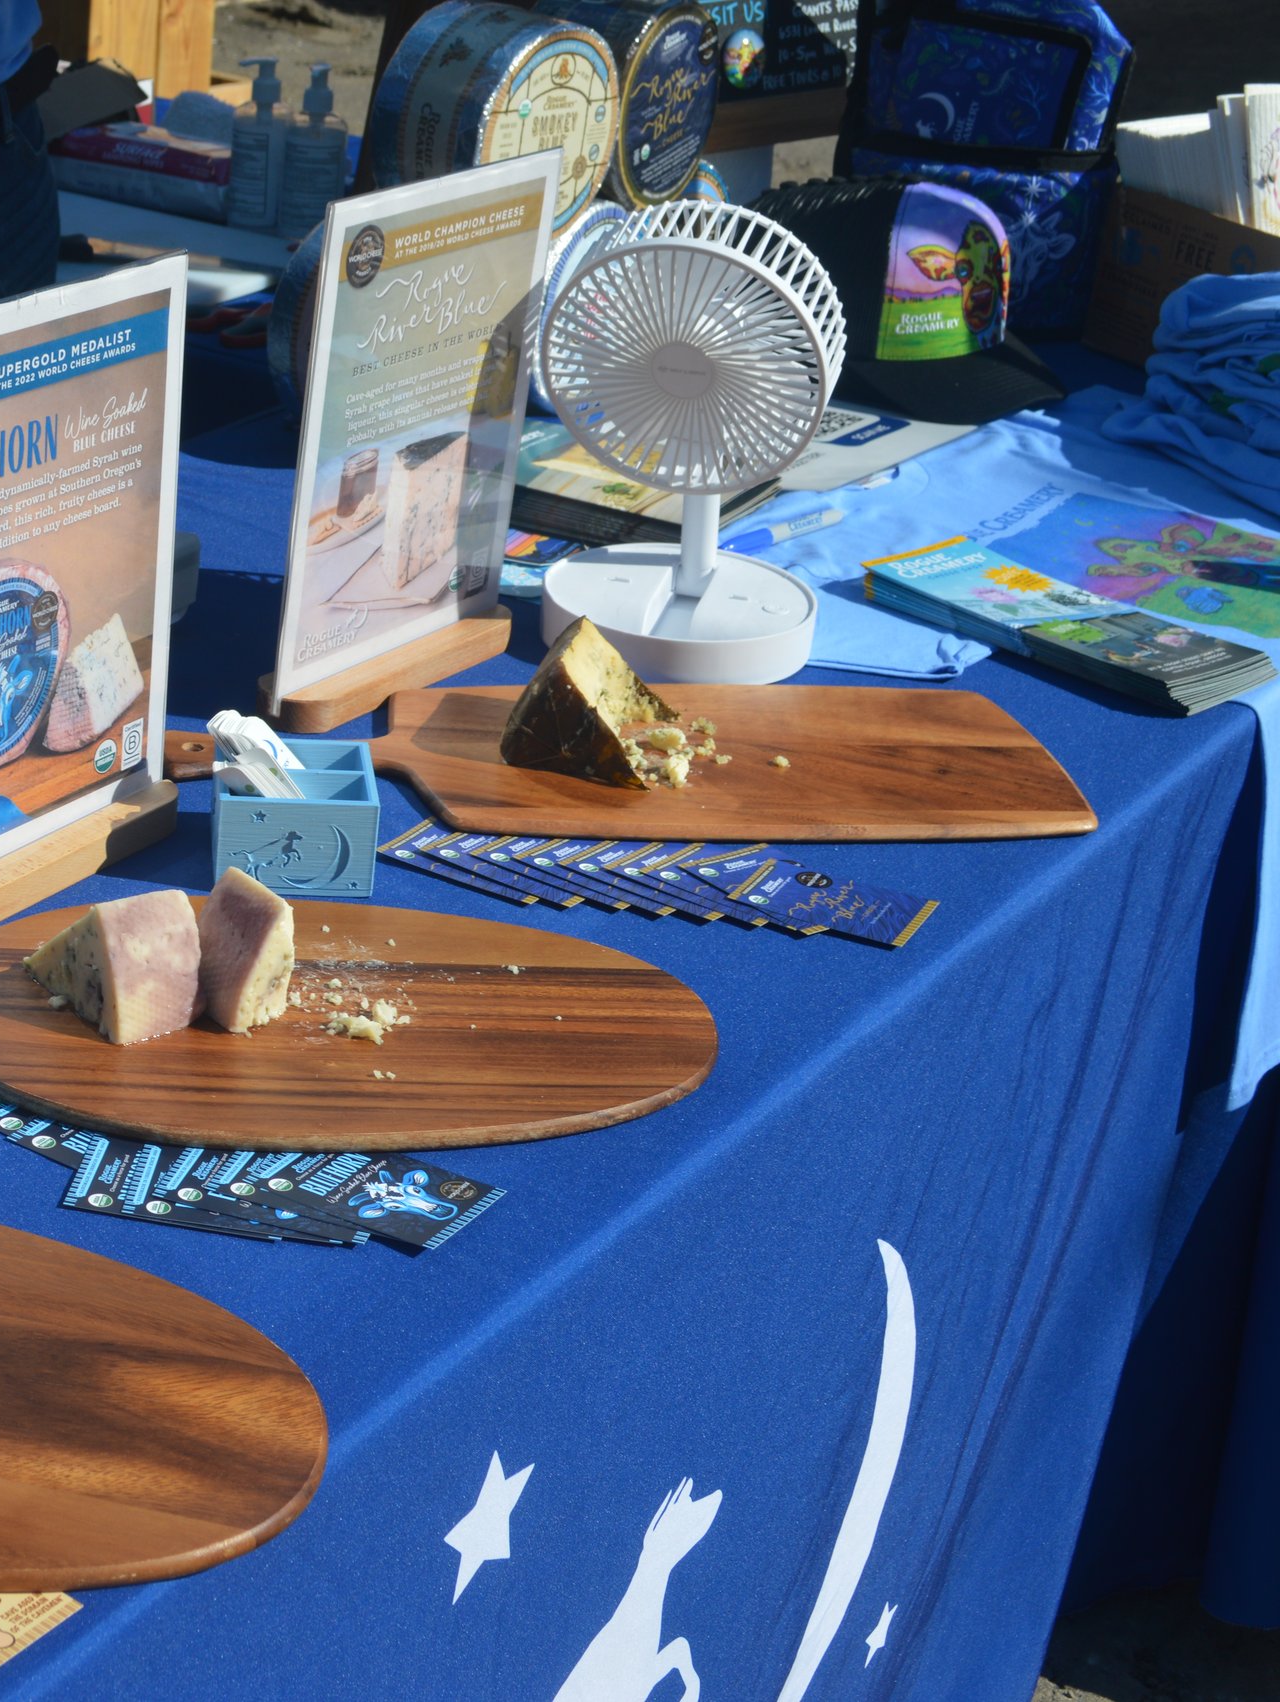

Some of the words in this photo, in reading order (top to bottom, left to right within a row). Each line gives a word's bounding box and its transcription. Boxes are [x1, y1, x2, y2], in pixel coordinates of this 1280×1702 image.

[742, 0, 765, 24] US
[531, 111, 578, 137] SMOKEY
[640, 99, 694, 140] Blue
[394, 230, 432, 249] WORLD
[434, 215, 486, 239] CHAMPION
[488, 204, 525, 224] CHEESE
[394, 250, 403, 259] AT
[405, 246, 418, 257] THE
[446, 233, 470, 247] WORLD
[470, 226, 495, 240] CHEESE
[495, 218, 522, 233] AWARDS
[1175, 240, 1216, 272] FREE
[376, 260, 475, 312] Rogue
[436, 280, 507, 336] Blue
[894, 317, 960, 335] CREAMERY
[901, 312, 944, 326] ROGUE
[71, 328, 132, 356] MEDALIST
[357, 306, 435, 353] River
[15, 372, 36, 387] 2022
[37, 363, 68, 380] WORLD
[70, 354, 101, 370] CHEESE
[102, 342, 136, 360] AWARDS
[352, 360, 381, 378] BEST
[383, 346, 425, 368] CHEESE
[426, 340, 440, 353] IN
[443, 332, 464, 349] THE
[346, 384, 384, 404] Cave-aged
[397, 376, 419, 389] many
[419, 366, 447, 381] months
[448, 359, 462, 372] and
[415, 385, 430, 398] that
[431, 379, 449, 391] have
[64, 406, 100, 440] Wine
[100, 388, 148, 427] Soaked
[379, 408, 393, 421] this
[425, 391, 449, 405] cheese
[73, 432, 96, 453] BLUE
[100, 421, 136, 444] CHEESE
[379, 421, 395, 434] with
[92, 450, 120, 470] Syrah
[121, 443, 143, 457] wine
[14, 510, 33, 526] this
[34, 504, 56, 521] rich,
[58, 495, 86, 513] fruity
[87, 484, 116, 502] cheese
[117, 480, 126, 492] is
[127, 478, 134, 487] a
[15, 495, 46, 514] grown
[48, 491, 58, 501] at
[59, 473, 101, 498] Southern
[978, 481, 1065, 532] CREAMERY
[32, 525, 41, 537] to
[43, 518, 61, 536] any
[62, 507, 93, 527] cheese
[94, 498, 122, 517] board.
[888, 552, 952, 573] ROGUE
[897, 551, 988, 579] CREAMERY
[297, 629, 357, 662] CREAMERY
[303, 623, 342, 648] ROGUE
[298, 1152, 372, 1196] BLUEHORN
